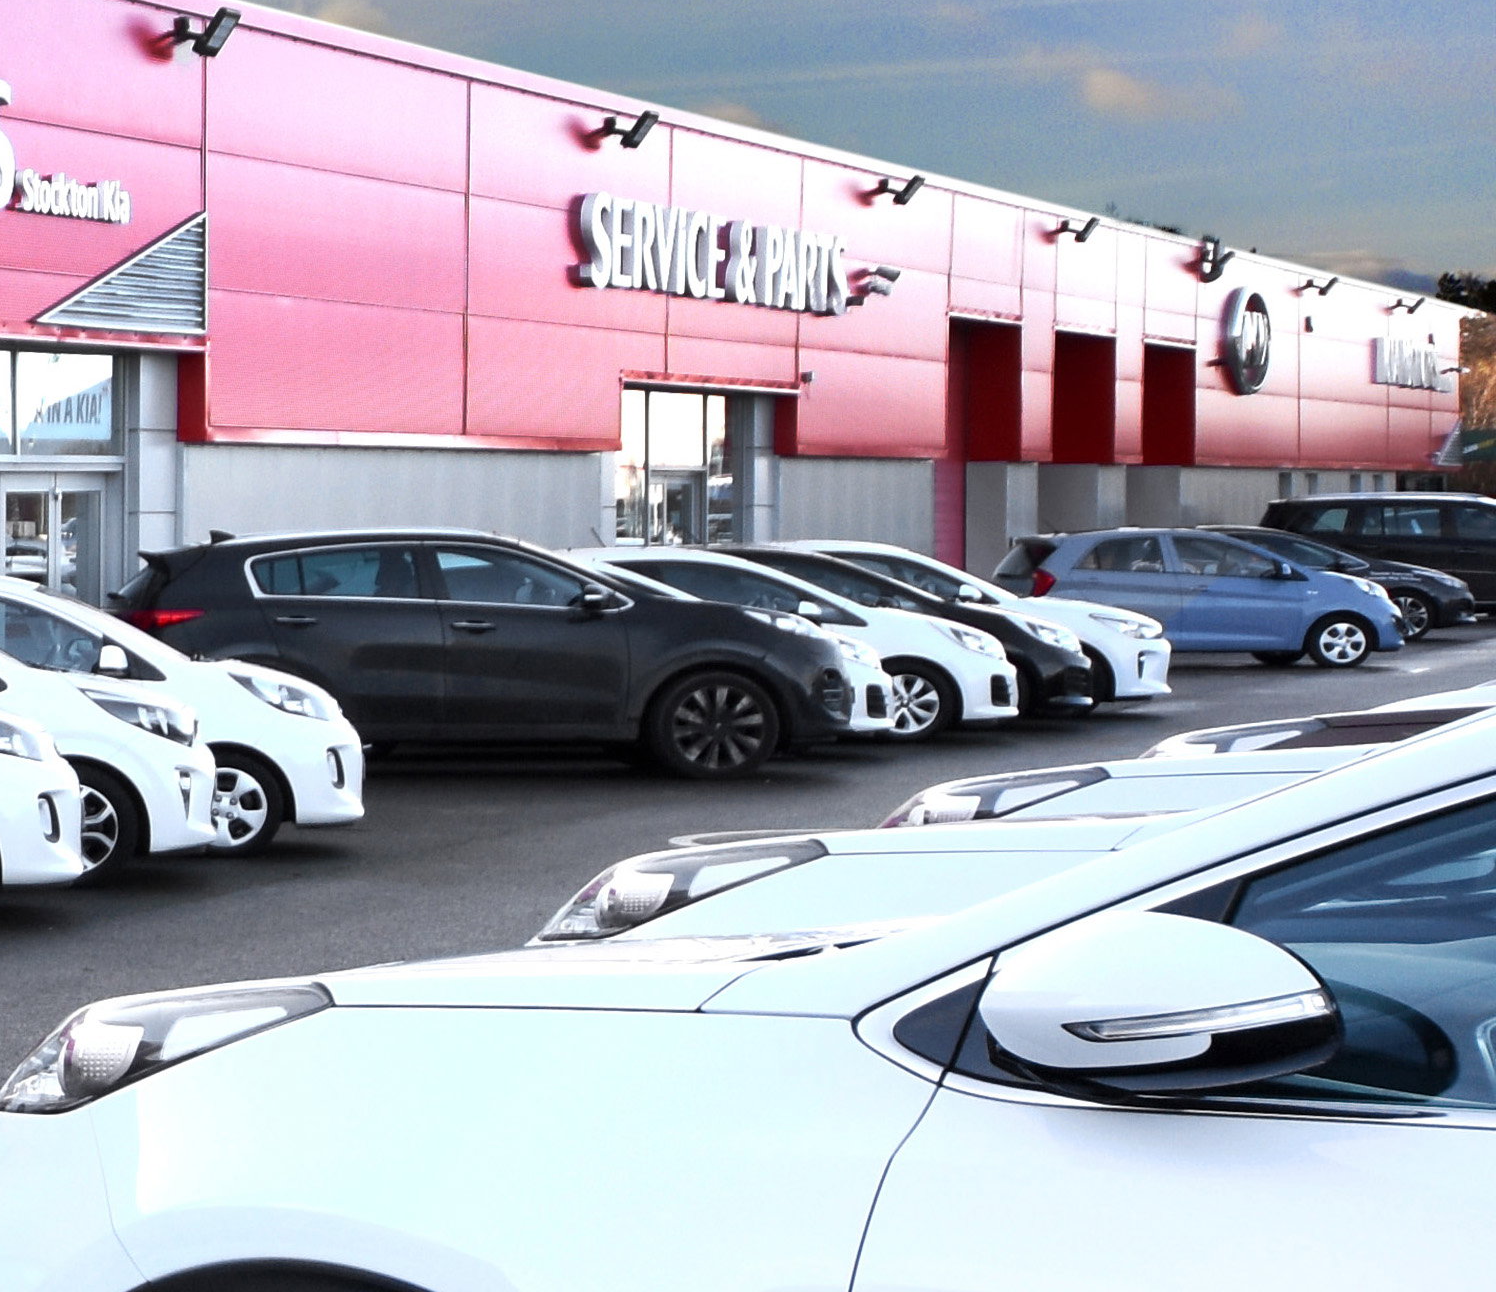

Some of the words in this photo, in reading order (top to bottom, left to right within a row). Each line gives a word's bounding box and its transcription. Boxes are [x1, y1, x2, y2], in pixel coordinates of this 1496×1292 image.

[19, 168, 99, 220] Stockton
[100, 180, 131, 224] Kia
[581, 192, 726, 298] SERVICE
[726, 219, 758, 305] &
[758, 225, 849, 315] PARTS
